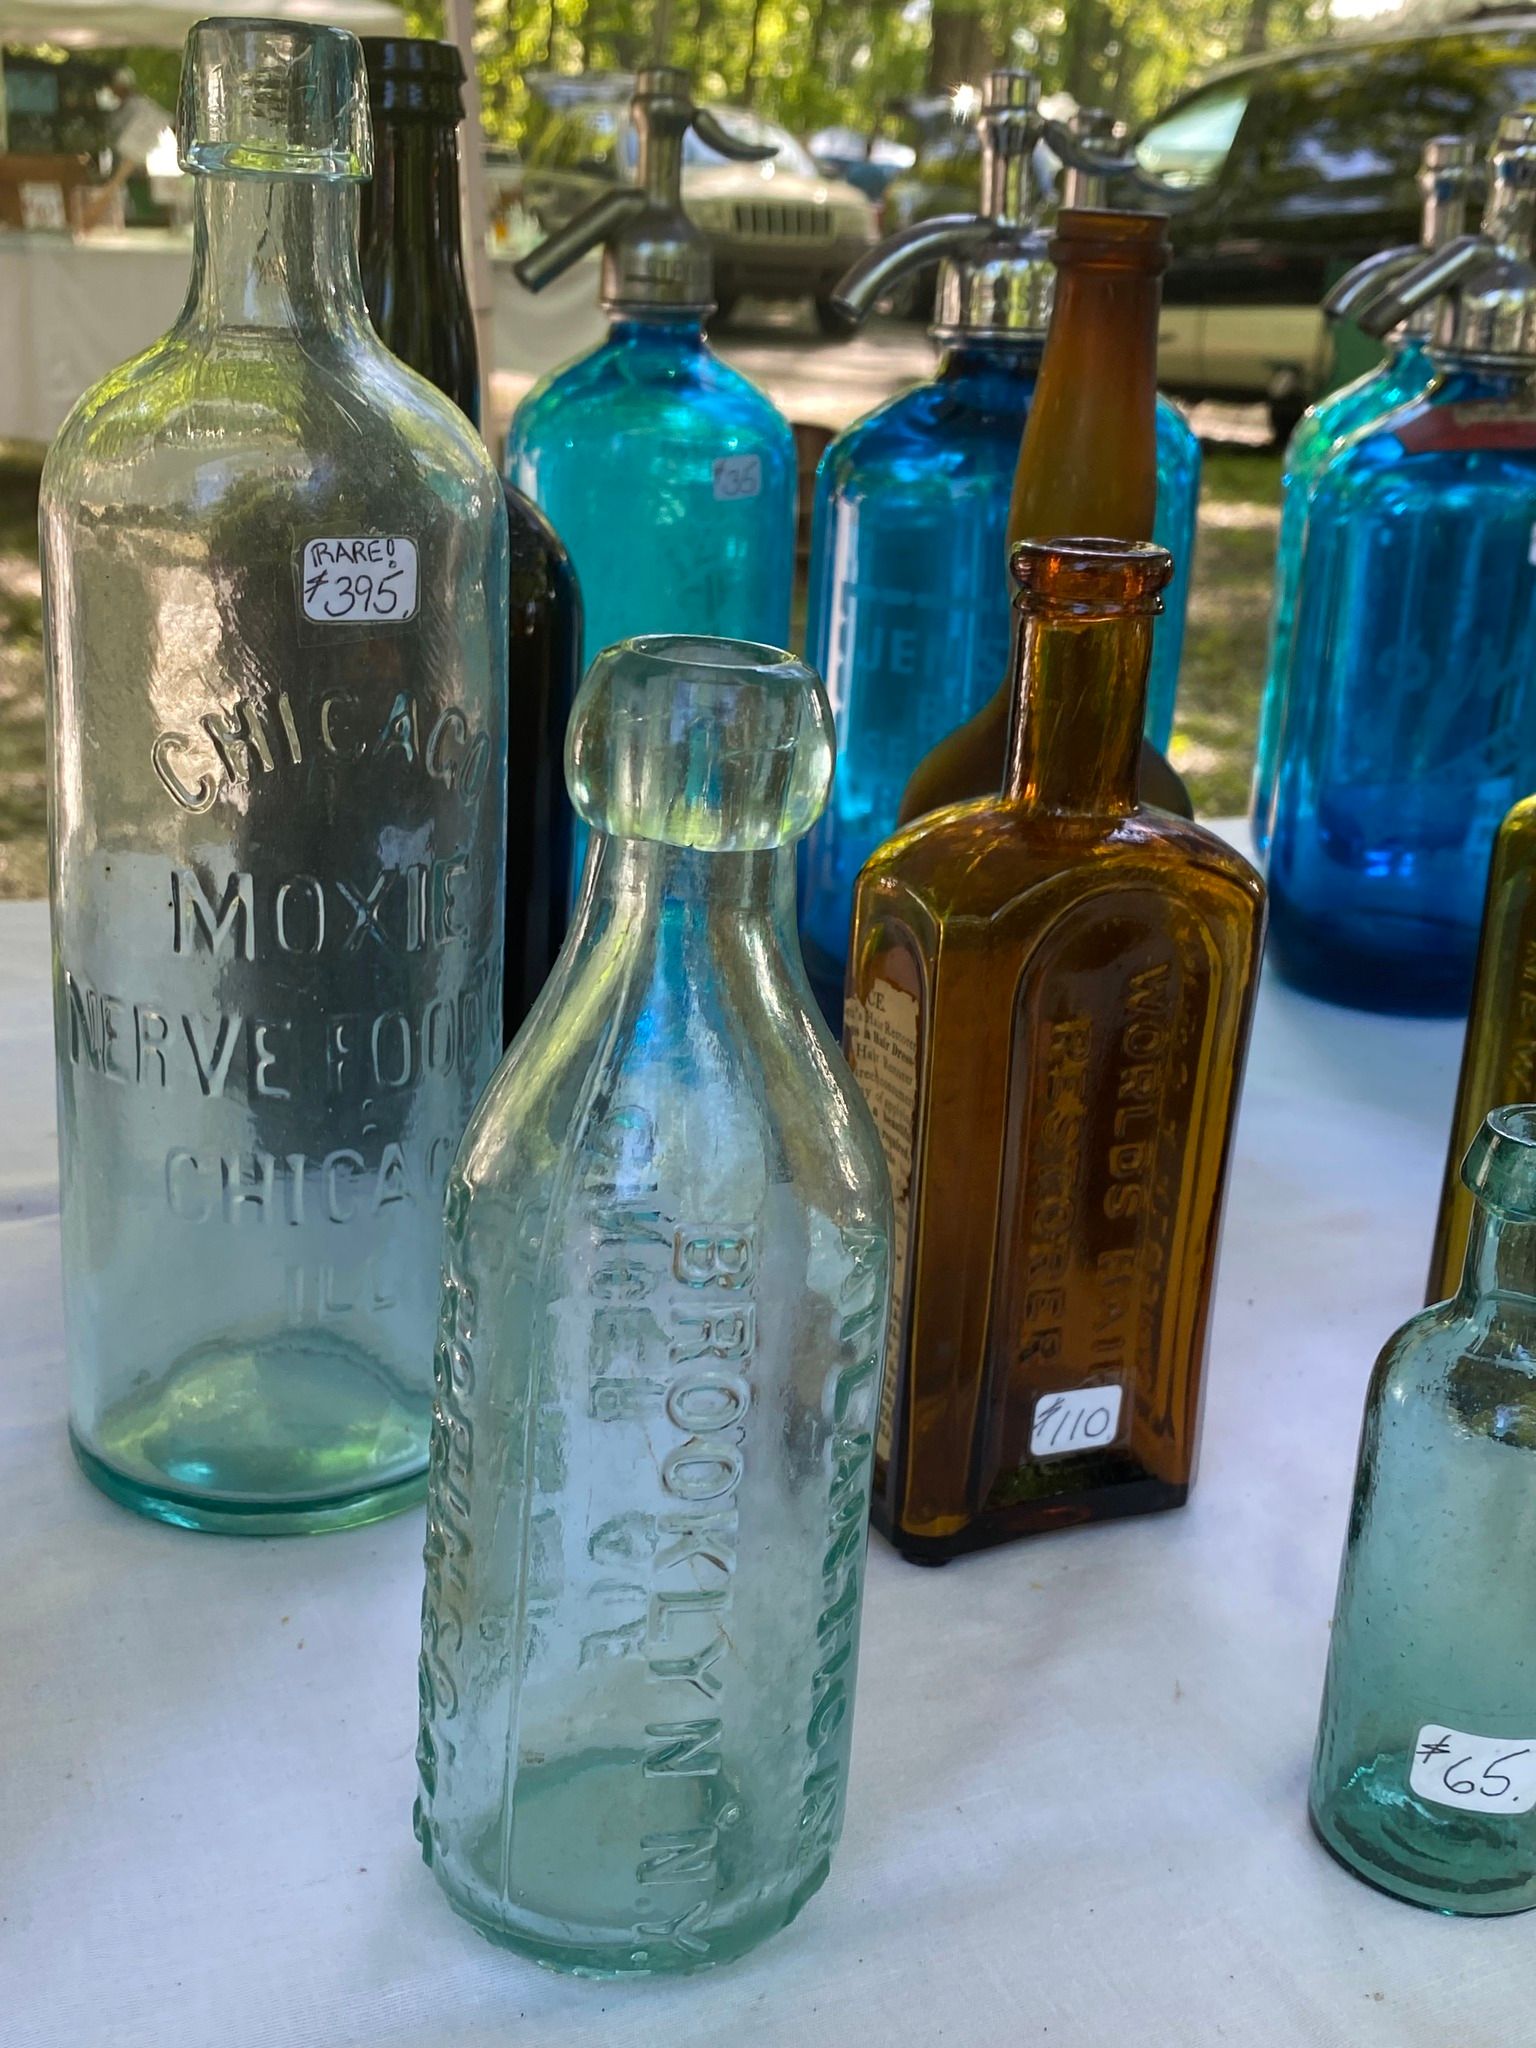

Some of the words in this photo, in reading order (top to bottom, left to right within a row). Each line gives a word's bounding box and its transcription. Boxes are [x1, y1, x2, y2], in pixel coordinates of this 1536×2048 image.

[311, 539, 397, 568] RARE!
[151, 691, 491, 815] CHICAGO
[170, 852, 470, 962] MOXIE
[66, 970, 292, 1099] NERVE
[328, 990, 484, 1092] FOOD
[1018, 1018, 1092, 1366] RESTORER
[643, 1224, 757, 1778] BROOKLYN
